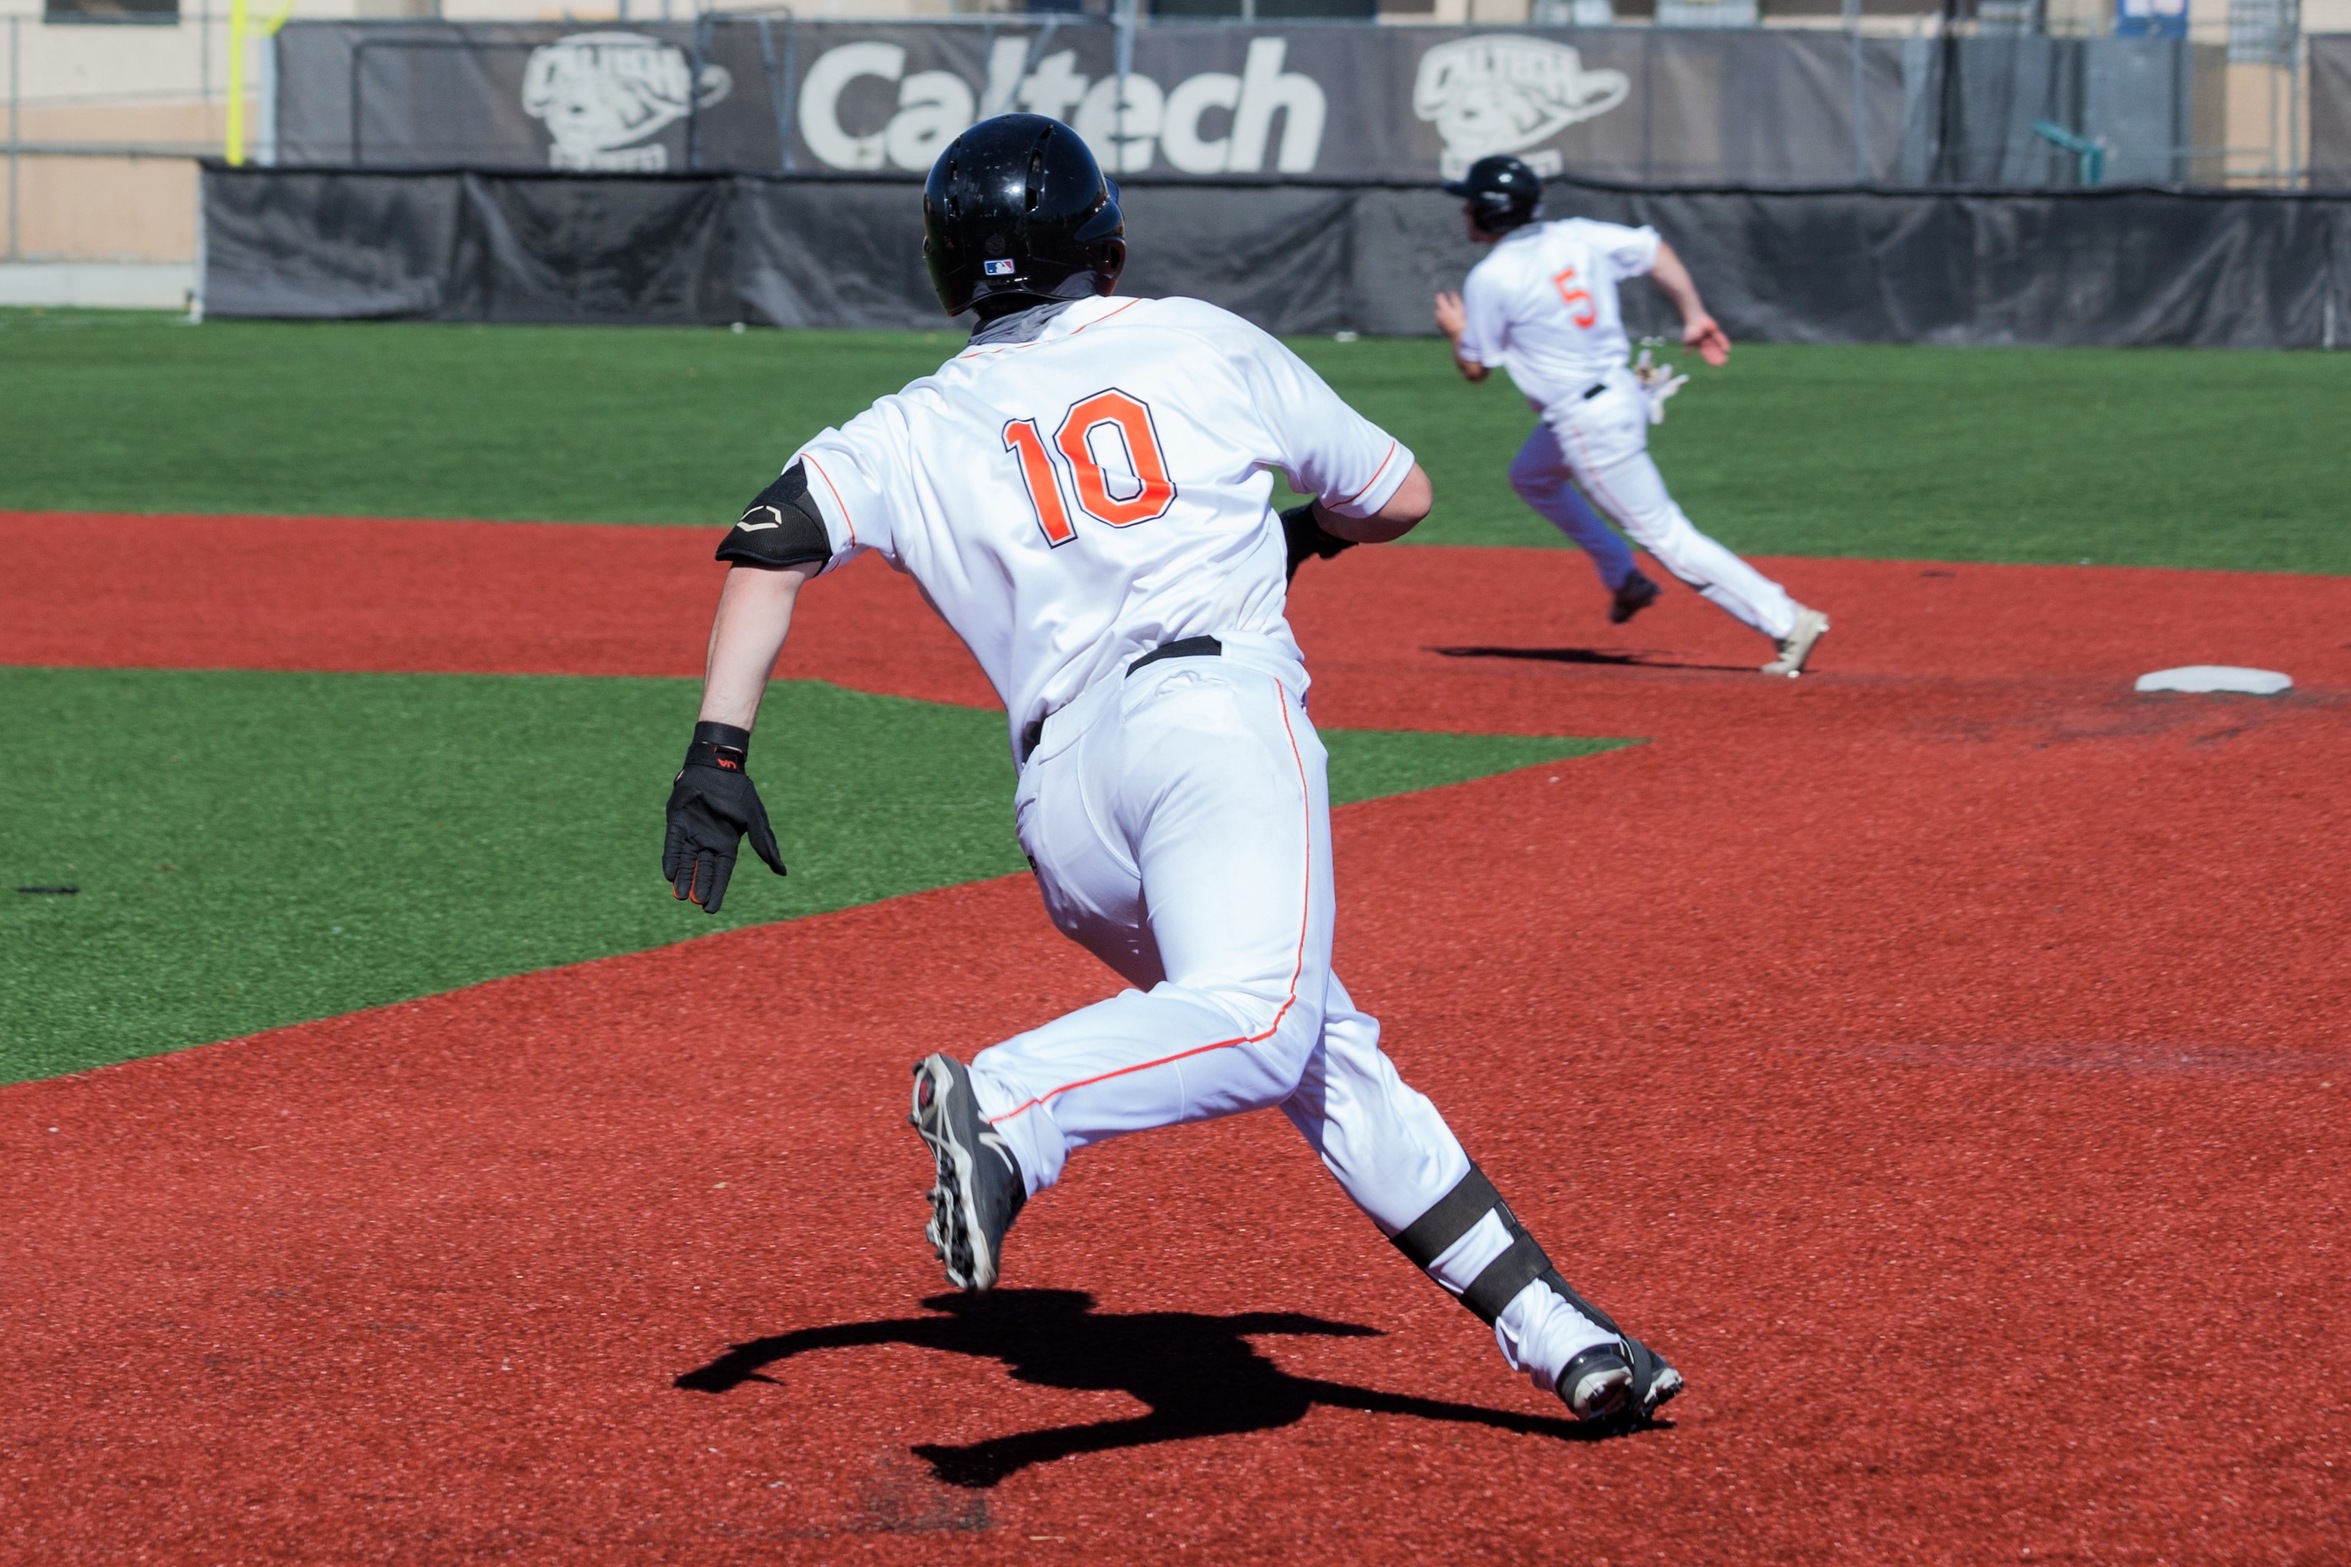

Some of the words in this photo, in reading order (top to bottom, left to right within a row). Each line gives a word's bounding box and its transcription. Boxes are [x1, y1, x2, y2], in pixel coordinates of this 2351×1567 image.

[798, 36, 1326, 174] Caltech
[1551, 265, 1597, 330] 5
[1002, 386, 1177, 549] 10
